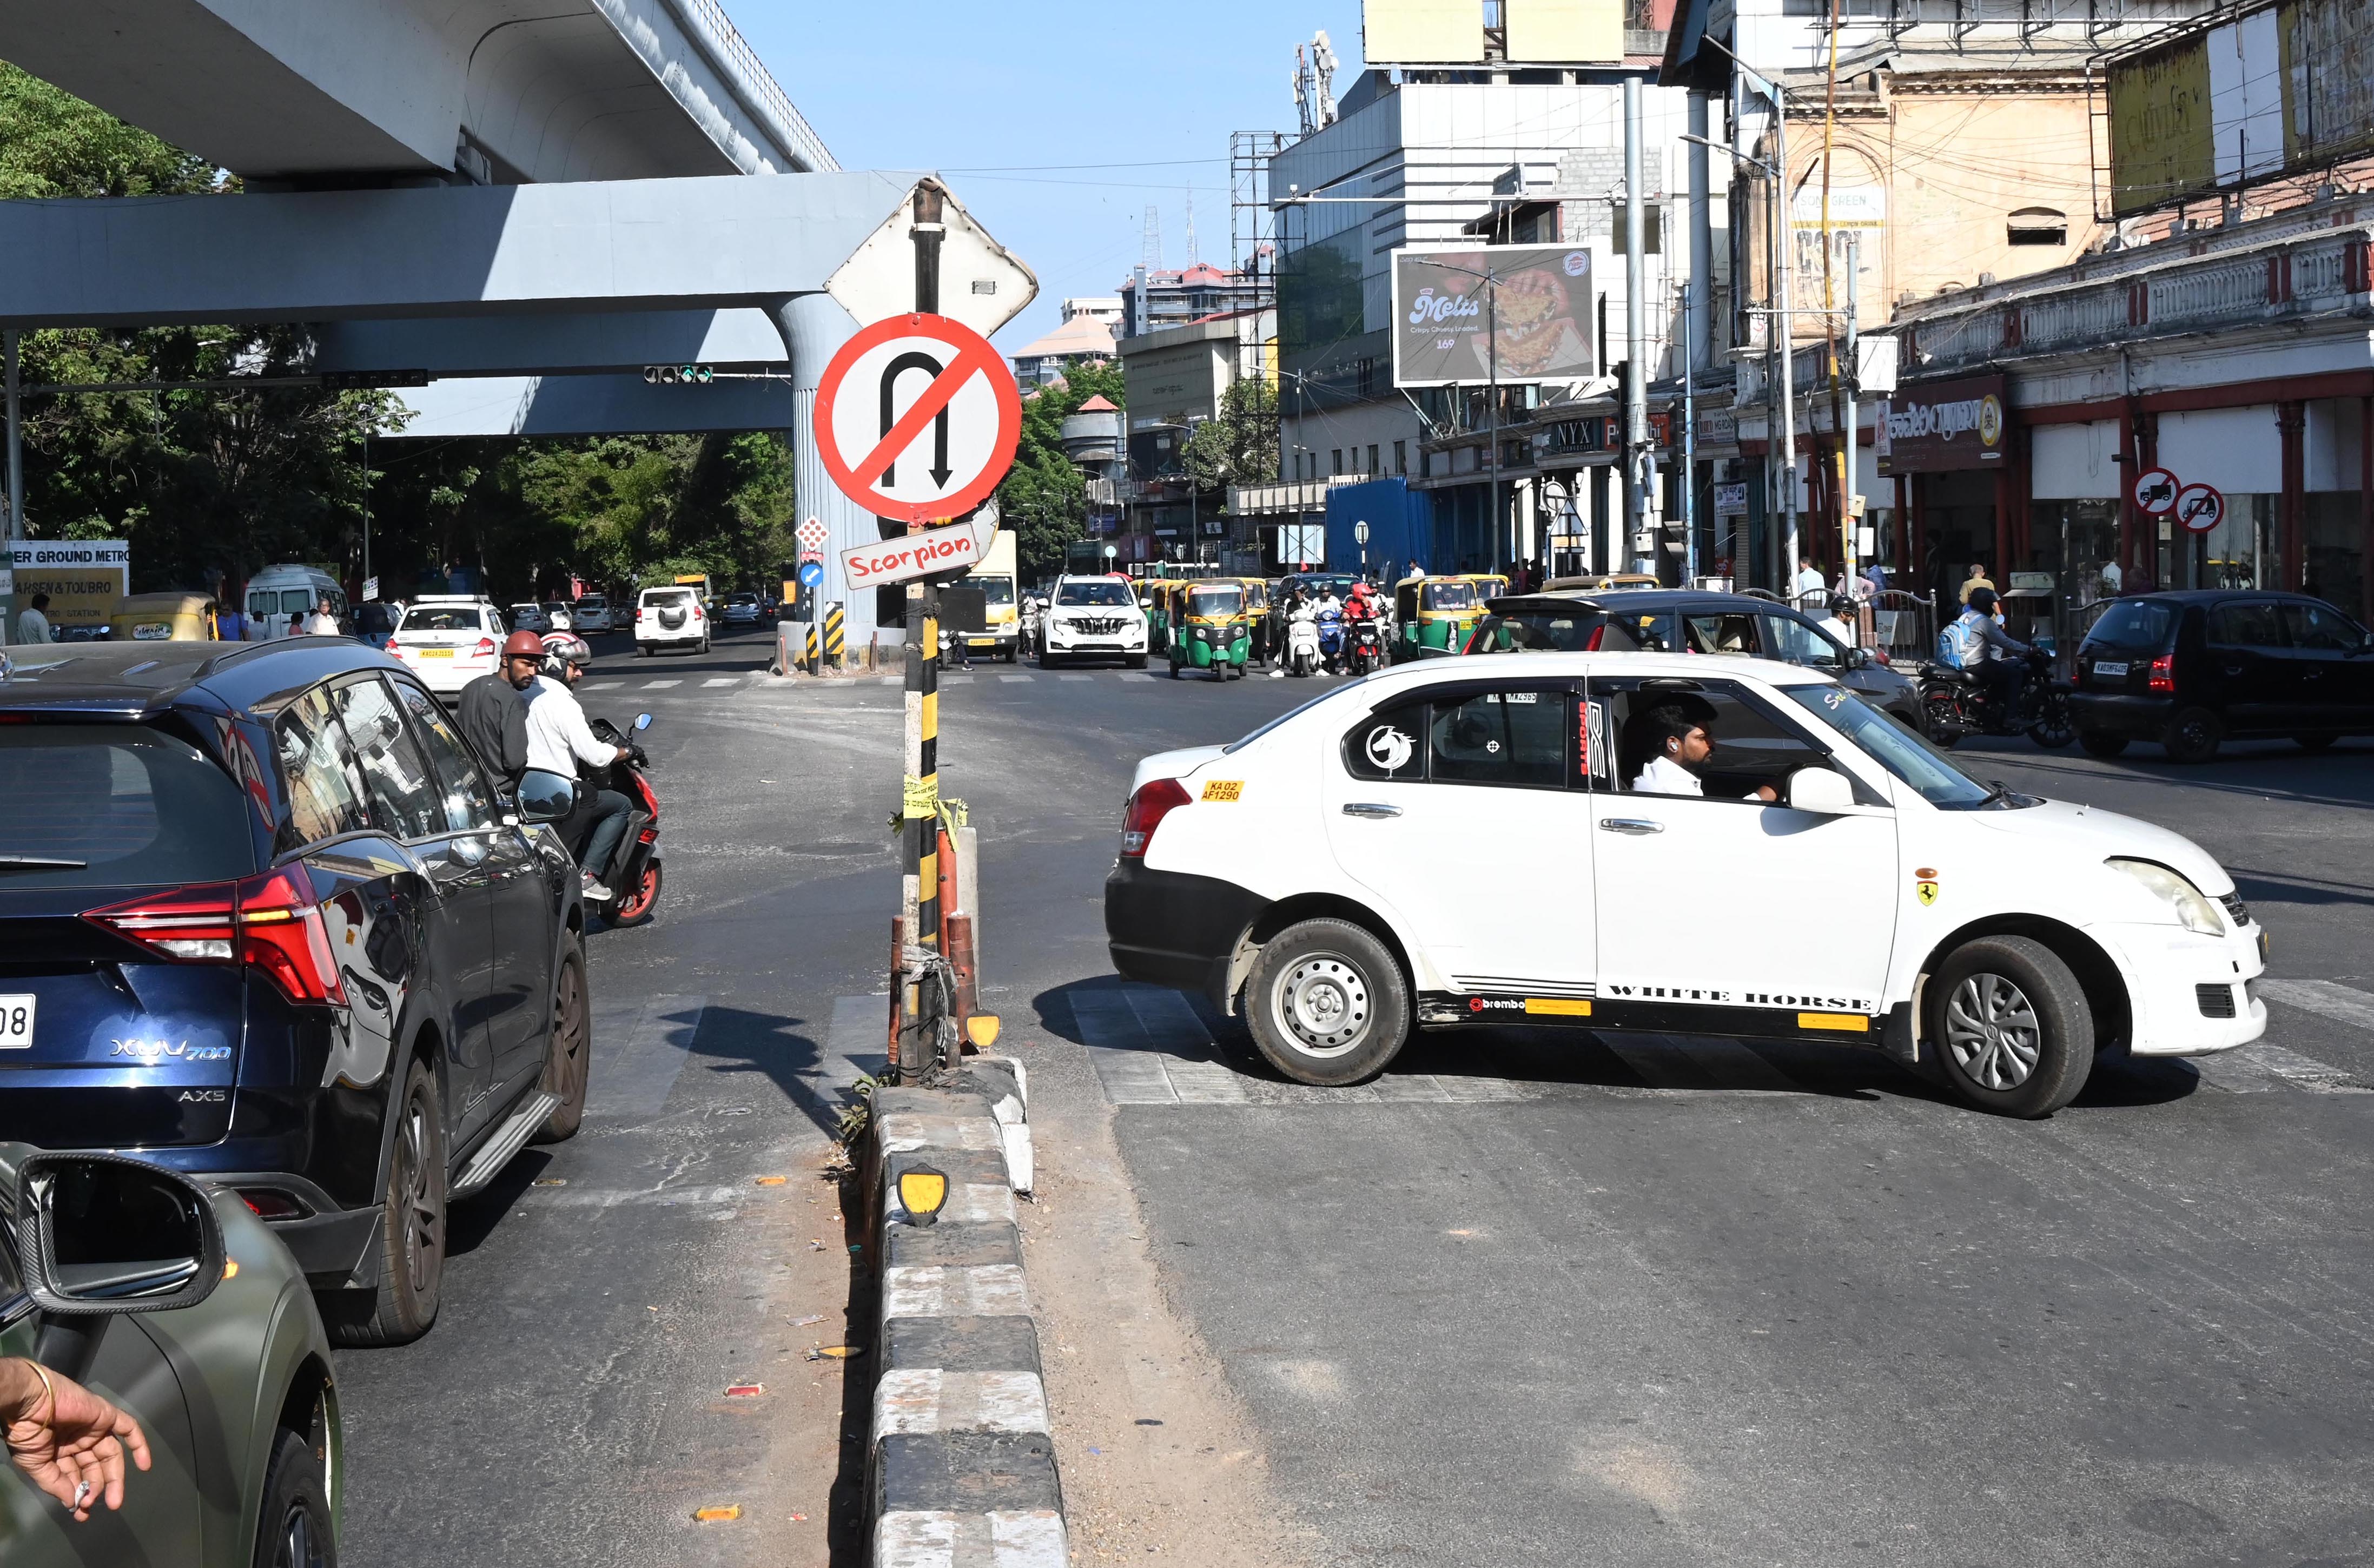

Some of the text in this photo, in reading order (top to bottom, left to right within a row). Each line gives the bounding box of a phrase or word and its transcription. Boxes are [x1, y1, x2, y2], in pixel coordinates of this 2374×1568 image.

[1832, 195, 1866, 206] GREEN
[1409, 294, 1479, 324] Melts
[1437, 339, 1454, 349] 169
[1557, 421, 1590, 446] NYX
[36, 550, 92, 563] GROUND
[848, 537, 971, 577] Scorpion
[55, 583, 64, 594] &
[65, 581, 111, 594] TOUBRO
[67, 610, 101, 618] STATION
[1578, 701, 1589, 776] SPORTS
[1210, 782, 1238, 790] KA 02
[1201, 791, 1239, 800] AF1290
[1482, 998, 1525, 1009] brembo
[1609, 985, 1872, 1010] WHITE HORSE
